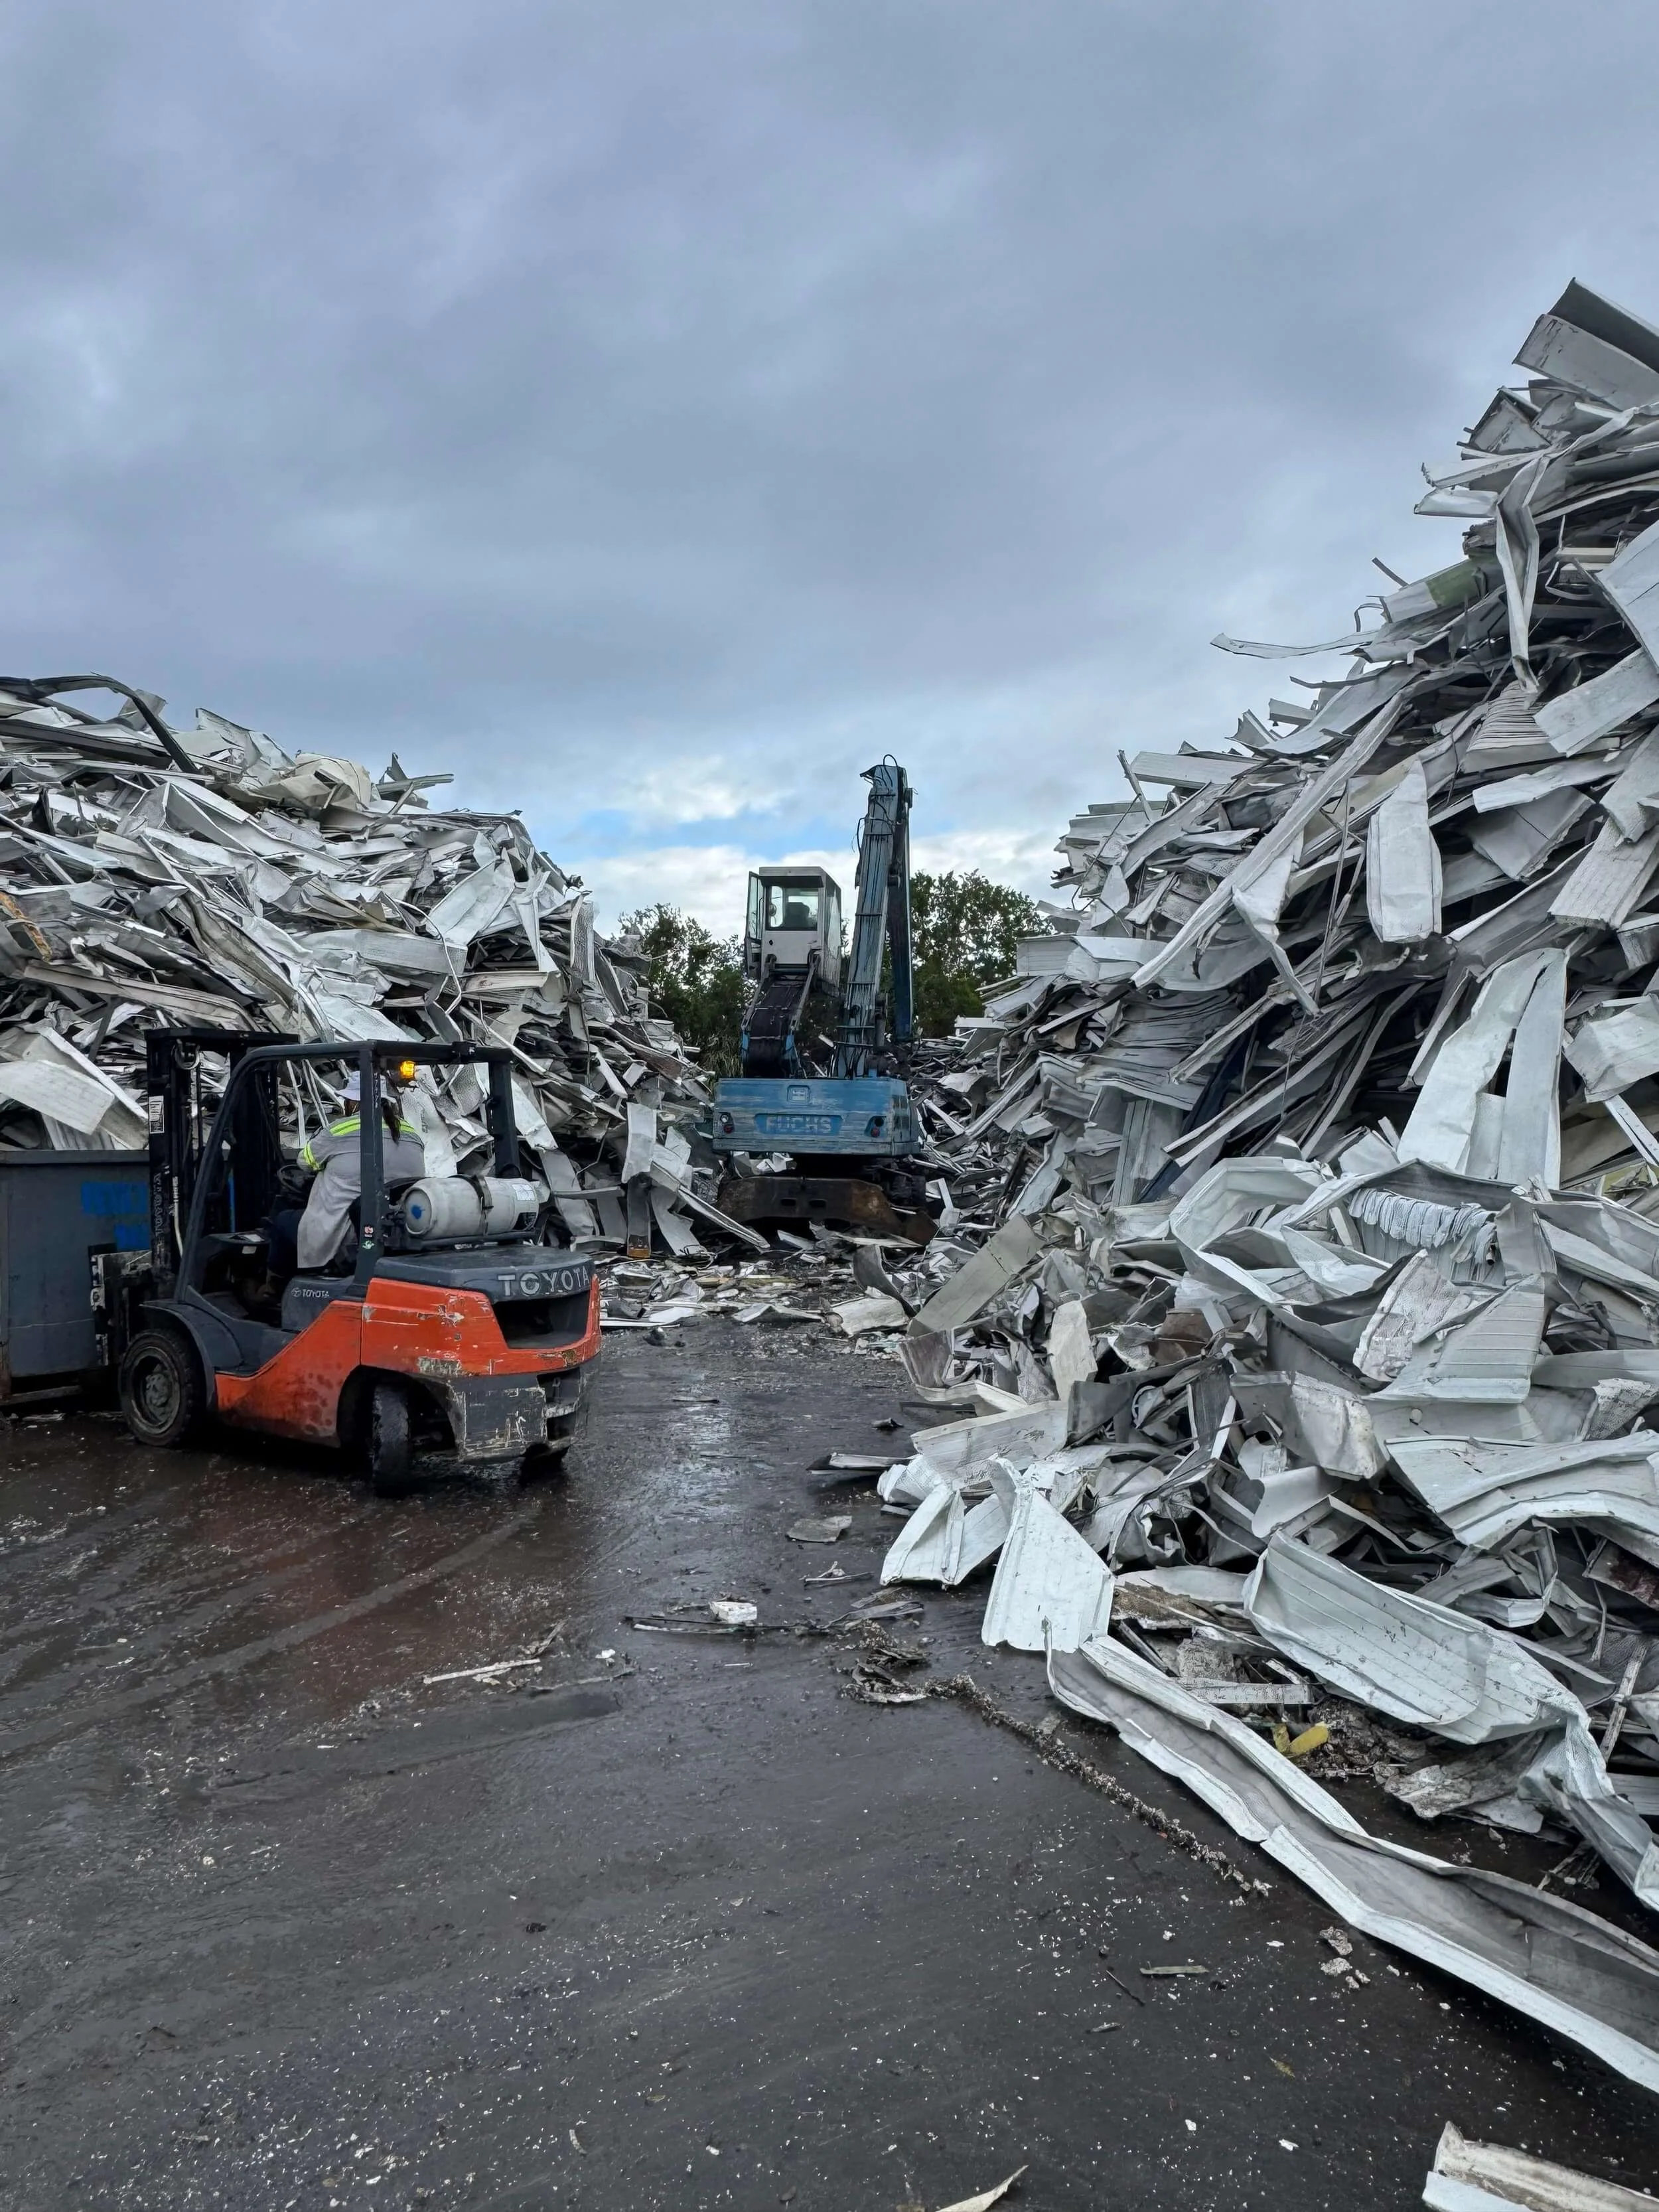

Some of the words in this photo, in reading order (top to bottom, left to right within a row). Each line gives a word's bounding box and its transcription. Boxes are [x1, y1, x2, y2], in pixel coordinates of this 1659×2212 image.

[766, 1116, 831, 1134] FUCHS
[497, 1266, 590, 1296] TOYOTA
[302, 1289, 330, 1299] TOYOTA
